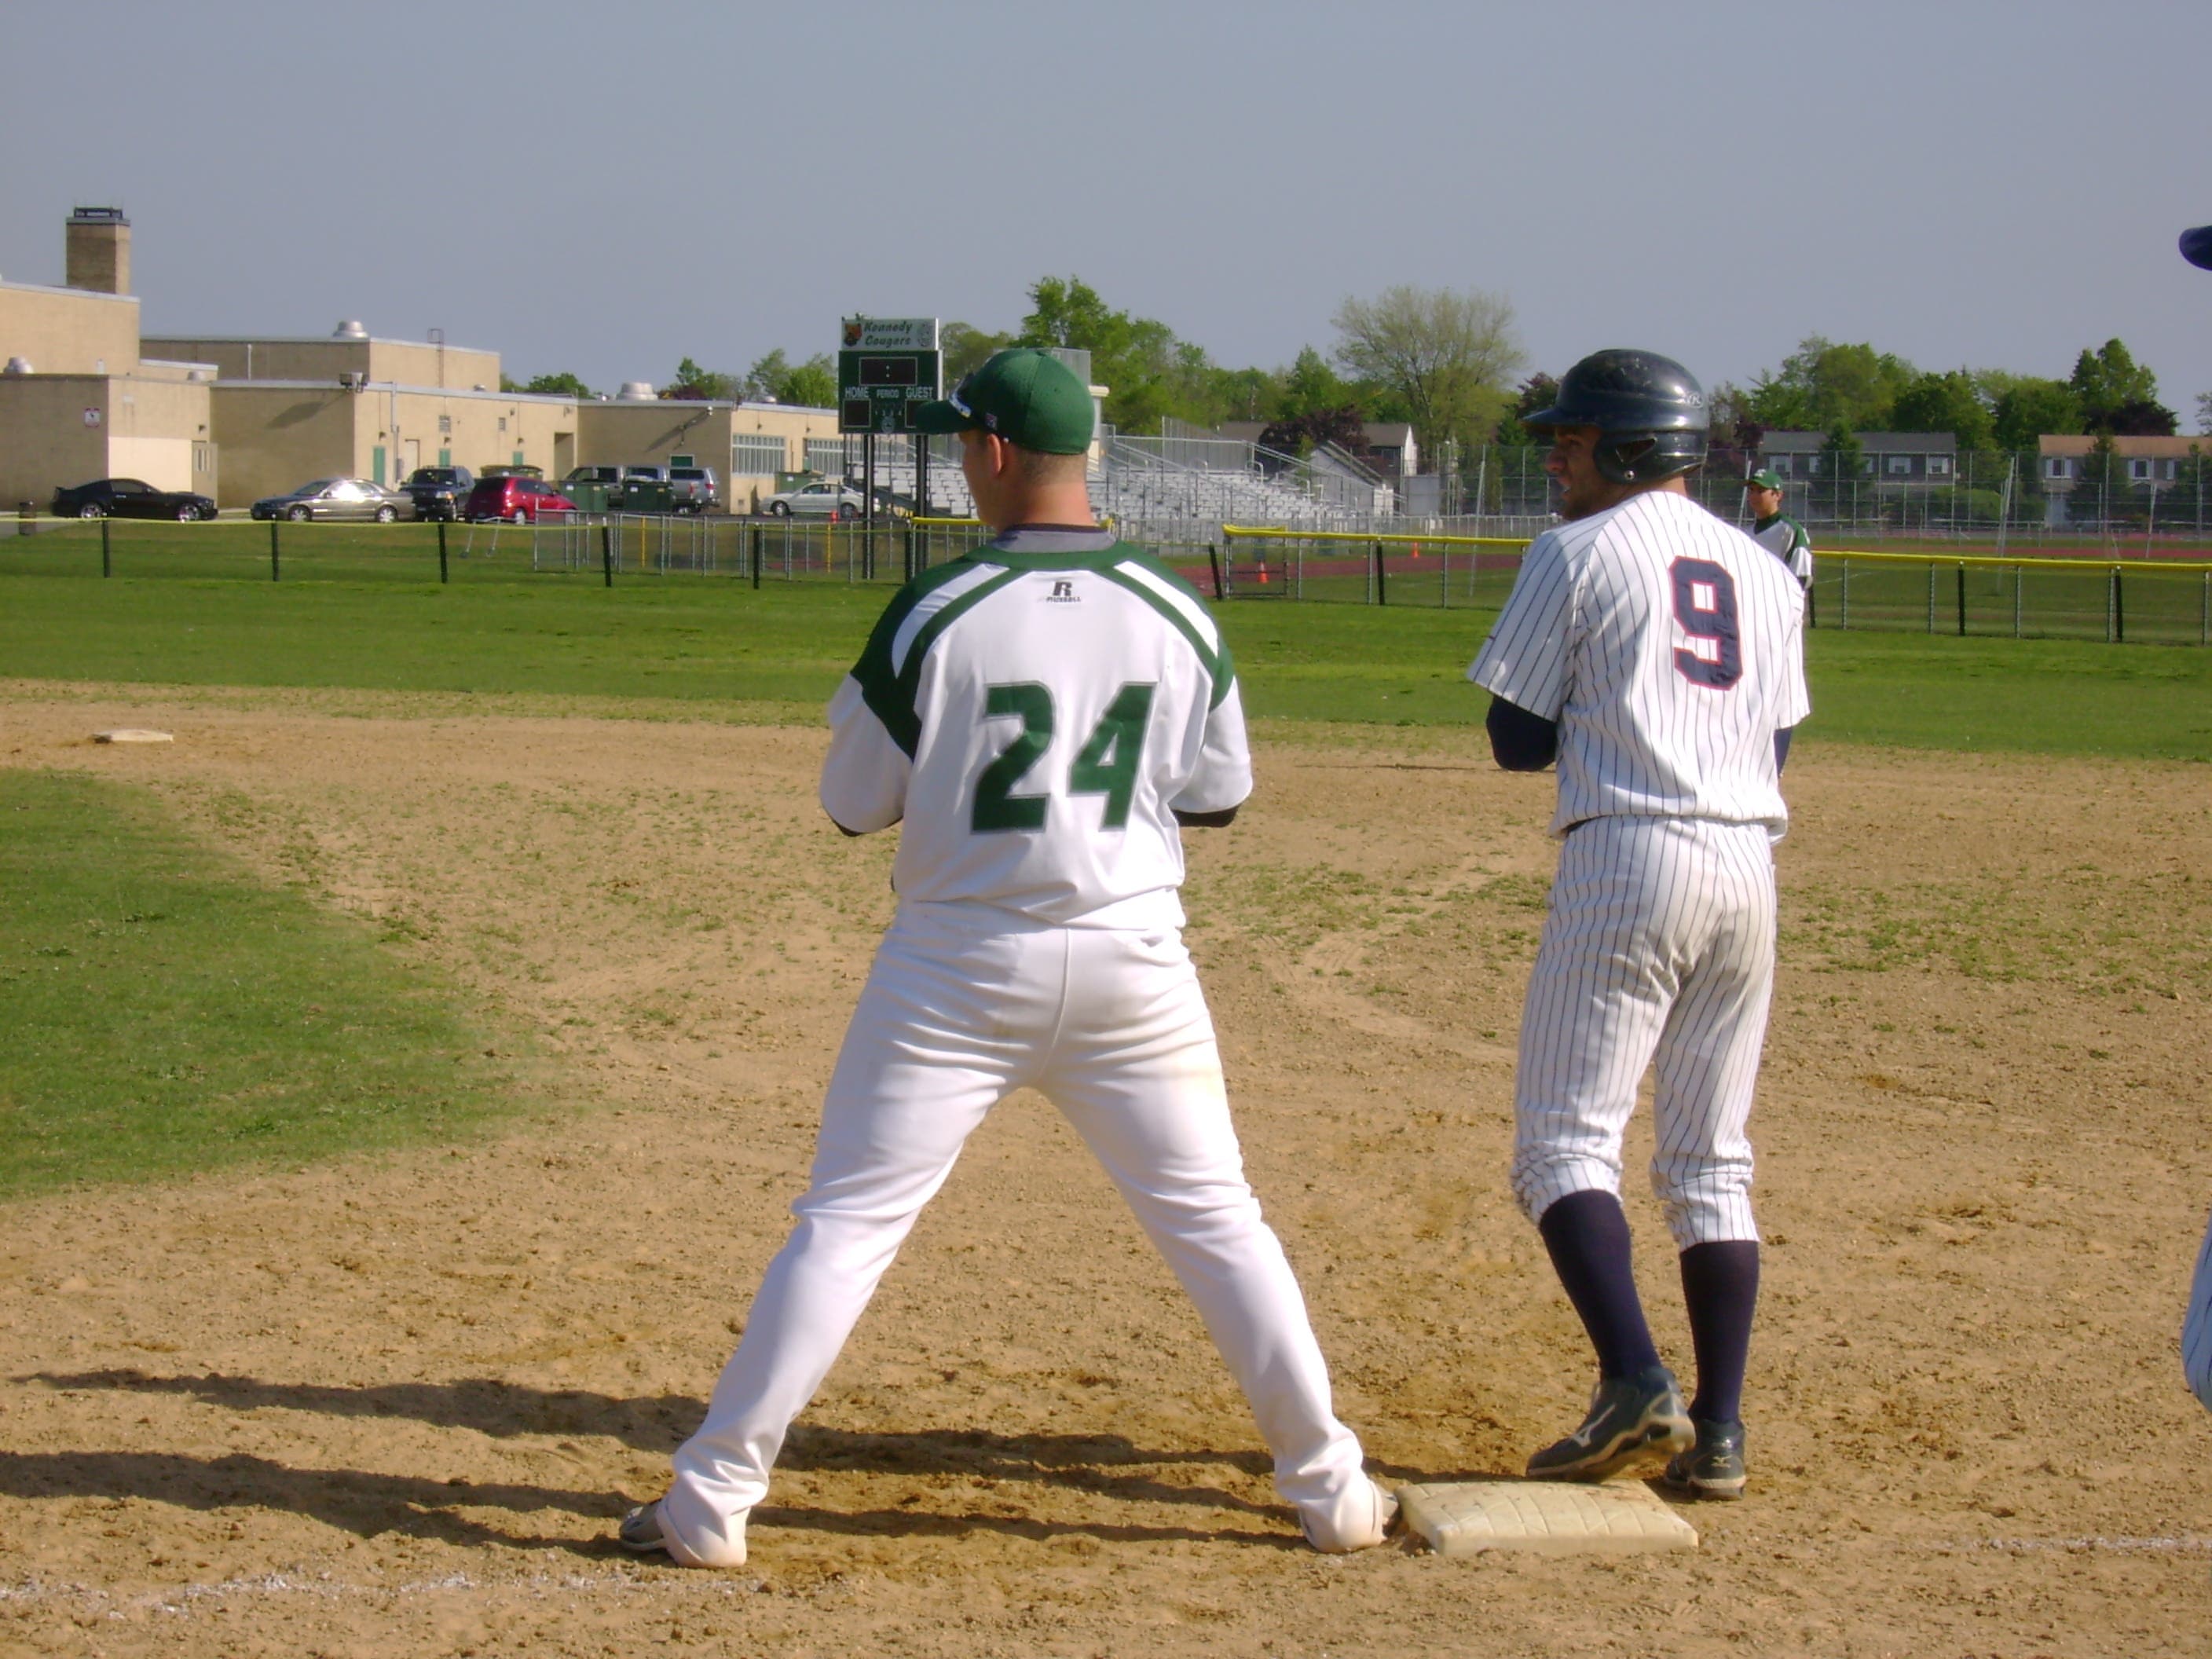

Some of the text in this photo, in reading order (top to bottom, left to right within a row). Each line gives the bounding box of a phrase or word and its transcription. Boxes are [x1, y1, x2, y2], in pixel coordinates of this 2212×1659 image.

[863, 320, 913, 334] Kennedy
[845, 386, 869, 398] HOME
[877, 389, 899, 398] PERIOD
[906, 386, 933, 398] GUEST
[1053, 582, 1072, 596] R
[1668, 555, 1744, 691] 9
[970, 680, 1159, 835] 24
